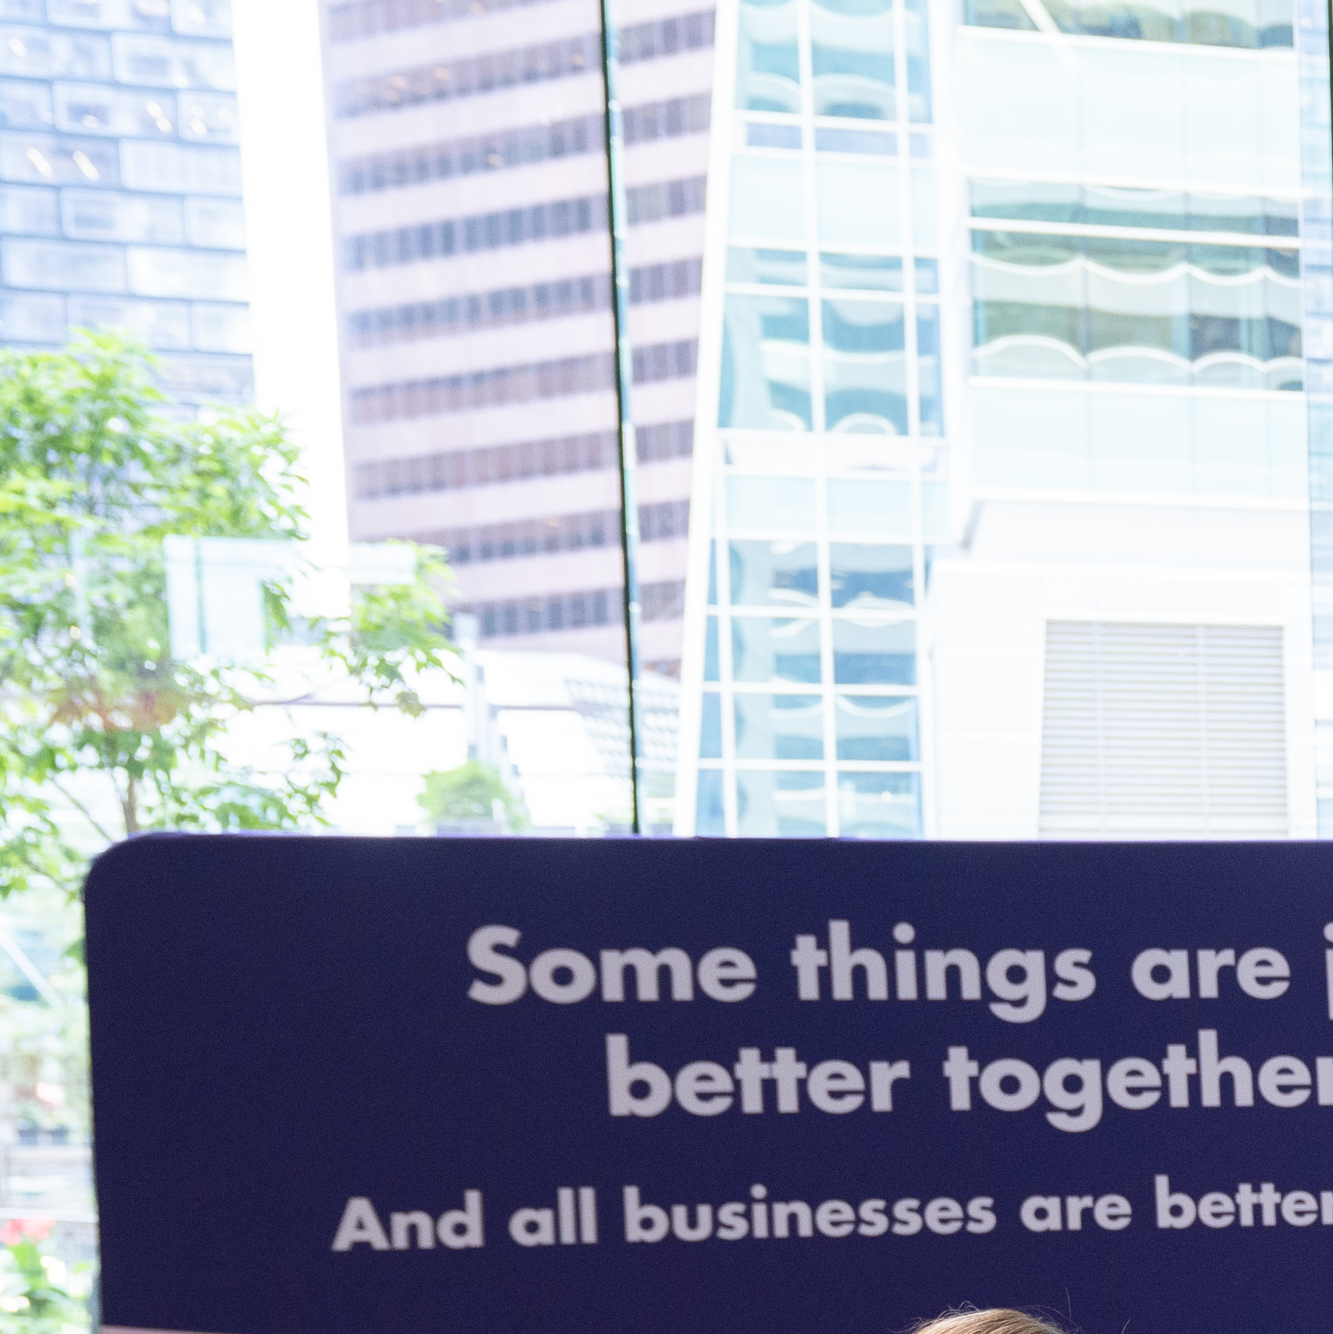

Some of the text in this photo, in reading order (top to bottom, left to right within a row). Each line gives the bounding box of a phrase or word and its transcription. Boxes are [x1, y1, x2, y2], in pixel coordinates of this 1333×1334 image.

[466, 924, 758, 1006] Some
[789, 919, 1097, 1025] things
[1130, 946, 1292, 1002] are
[605, 1032, 911, 1118] better
[331, 1189, 484, 1252] And
[508, 1186, 598, 1248] all
[622, 1183, 998, 1244] businesses
[1019, 1193, 1133, 1233] are
